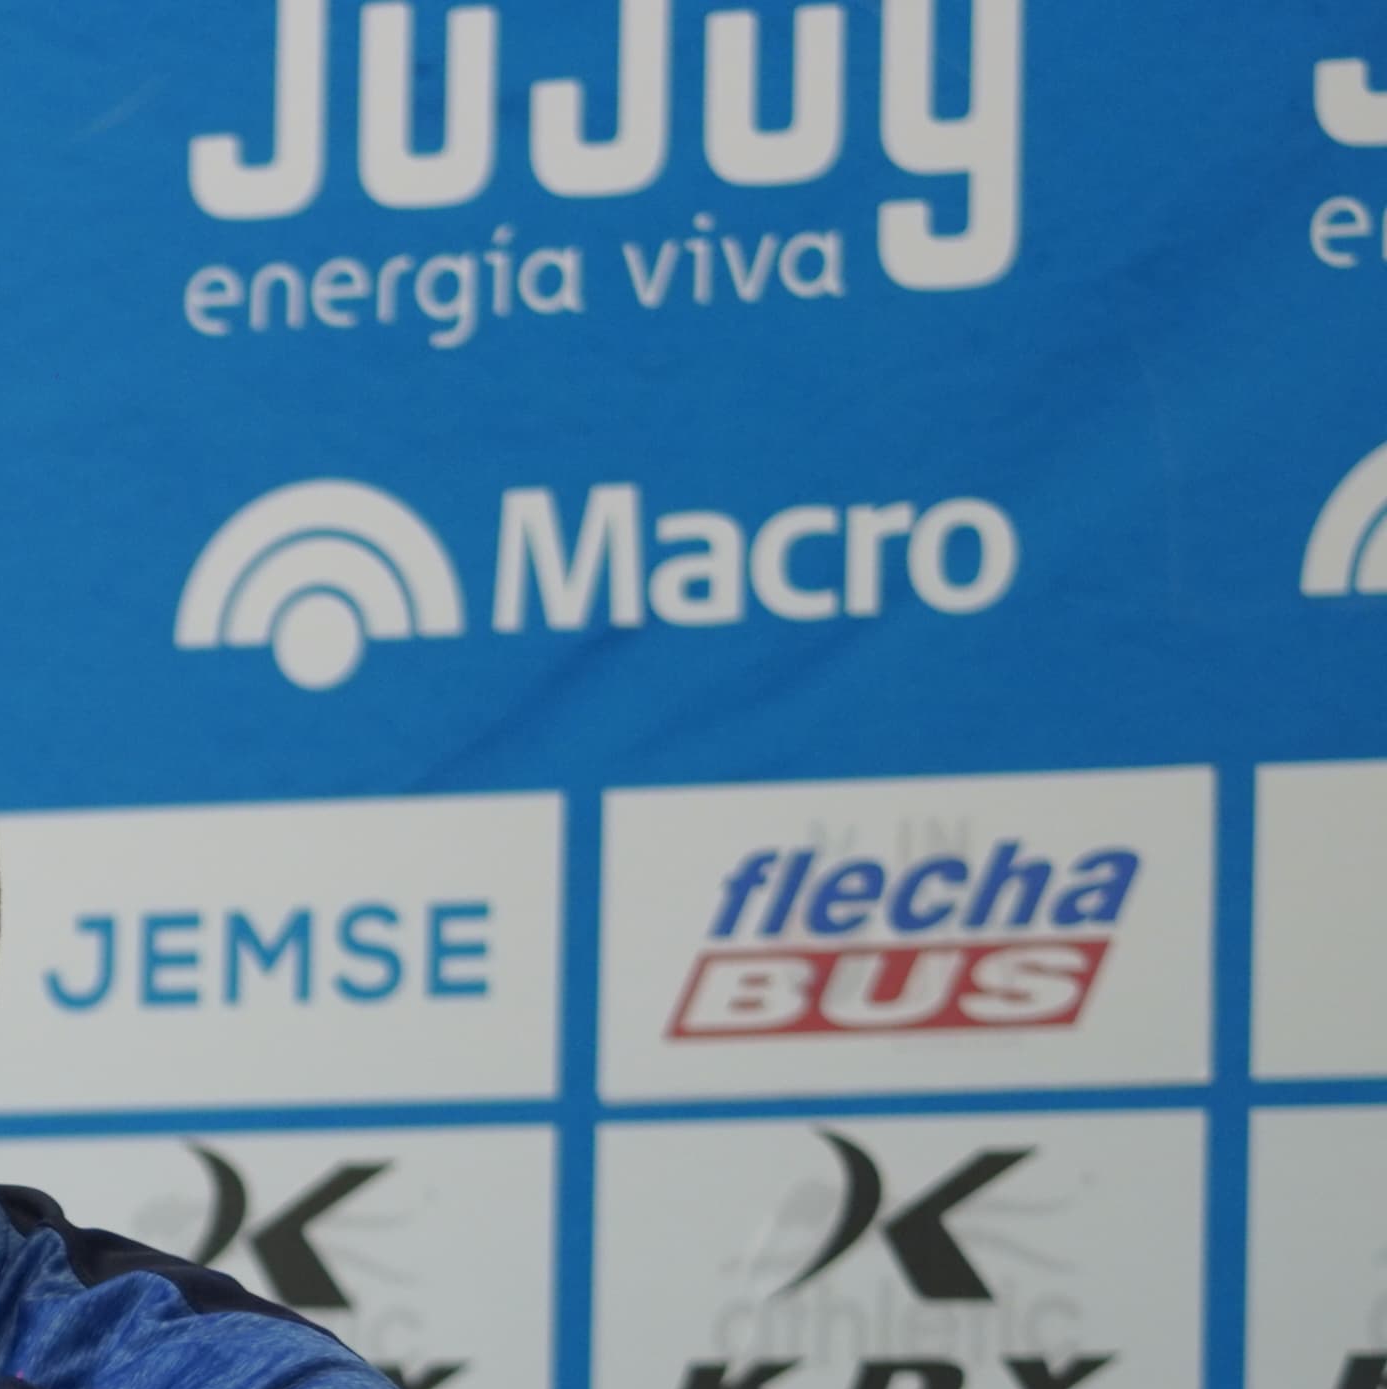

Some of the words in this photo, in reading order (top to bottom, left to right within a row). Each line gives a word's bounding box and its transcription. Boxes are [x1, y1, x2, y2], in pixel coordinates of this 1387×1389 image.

[185, 225, 583, 348] energía
[622, 213, 845, 308] viva
[490, 482, 1020, 634] Macro
[709, 841, 1143, 940] flecha
[43, 900, 492, 1013] JEMSE
[680, 943, 1088, 1033] BUS
